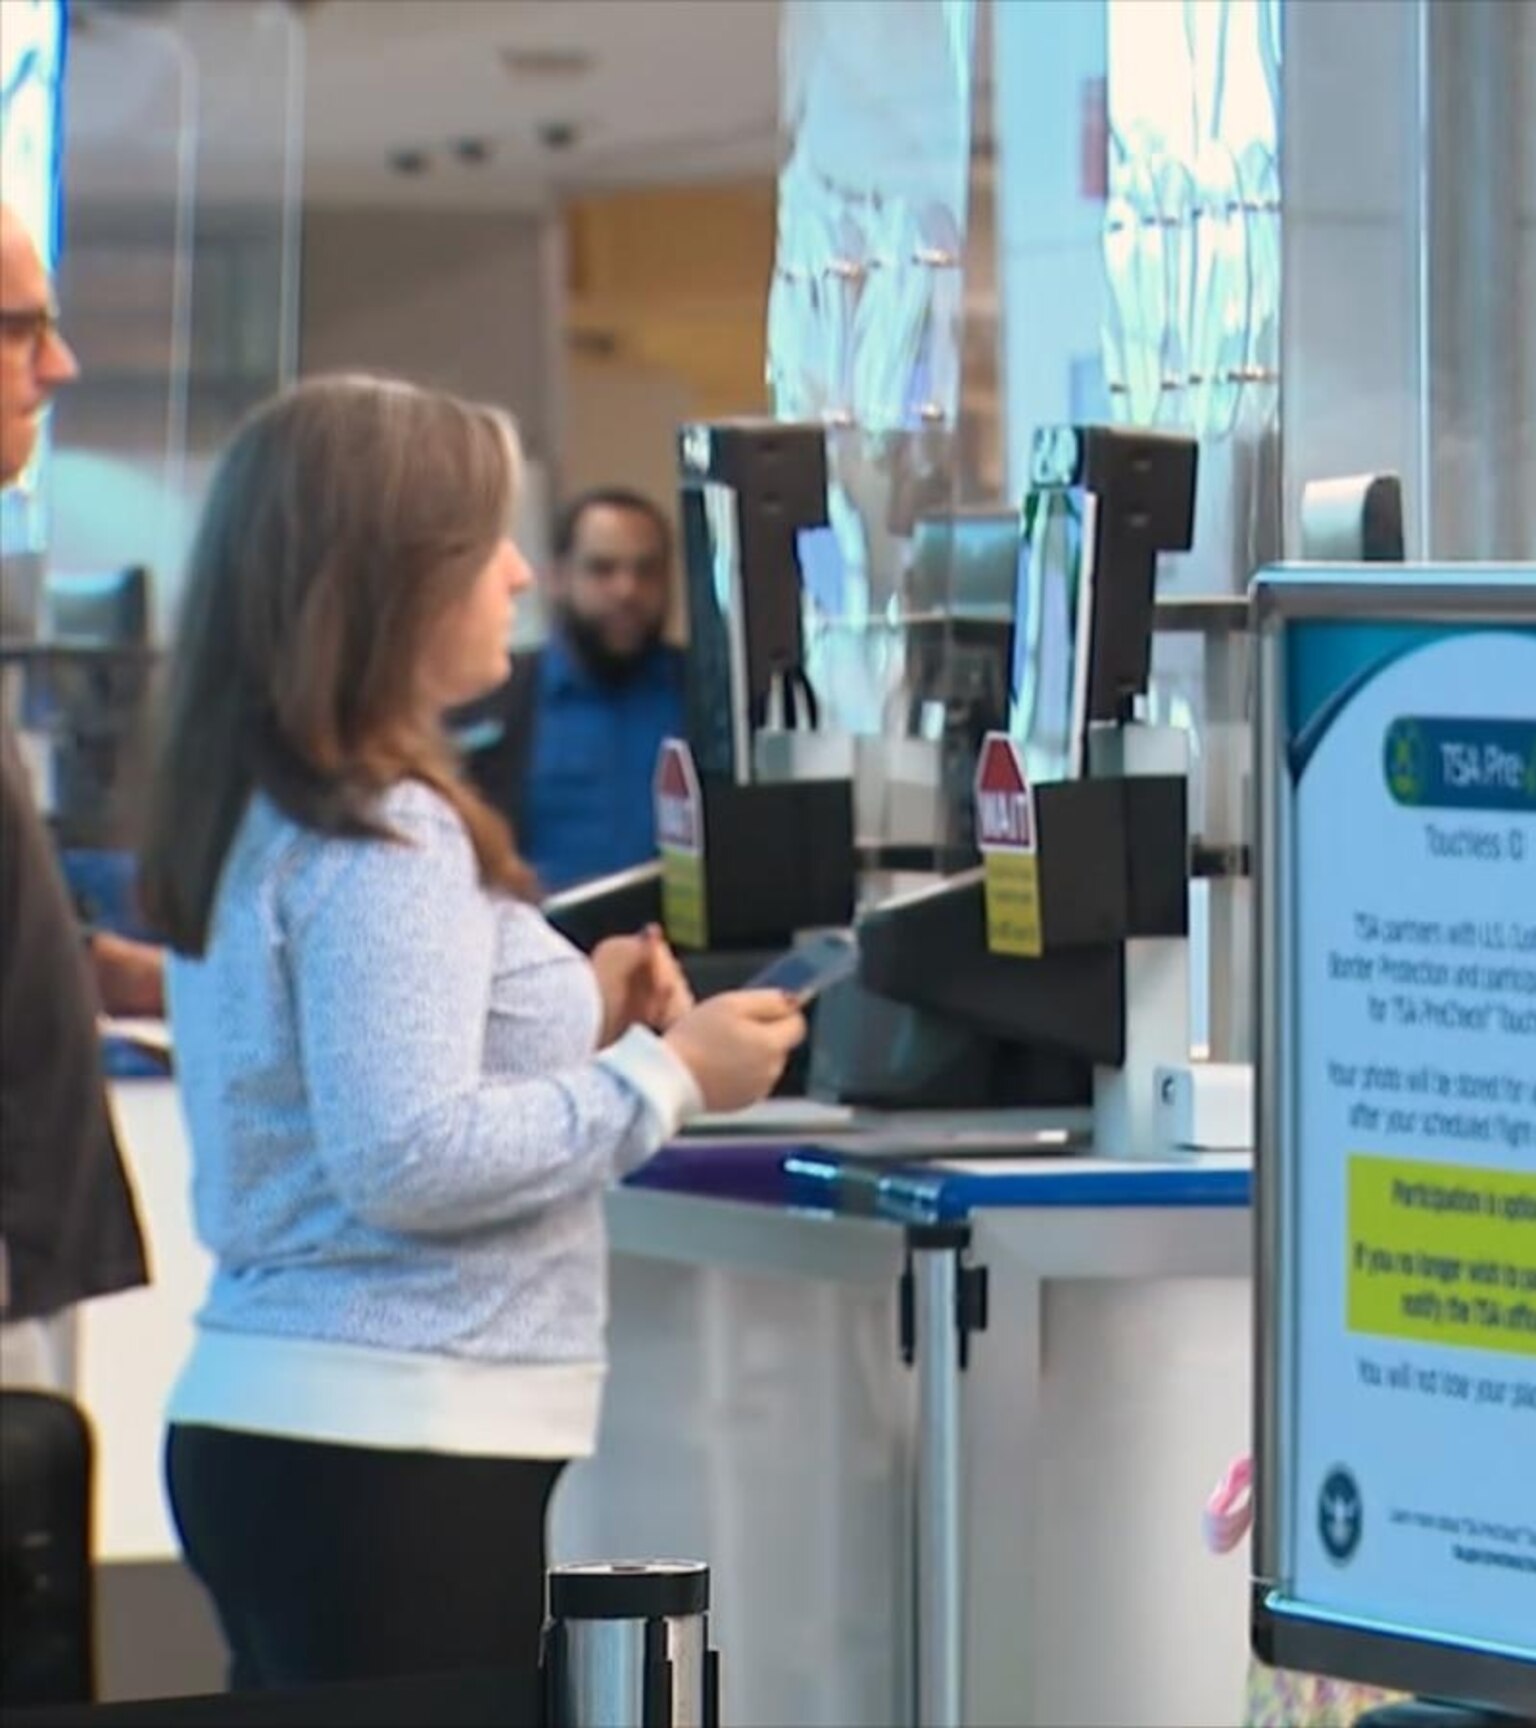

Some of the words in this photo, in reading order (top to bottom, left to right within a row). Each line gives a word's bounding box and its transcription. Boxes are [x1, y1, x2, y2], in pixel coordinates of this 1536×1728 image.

[1440, 743, 1480, 787] TSA
[1425, 823, 1501, 860] Touchless
[1391, 1178, 1480, 1216] Participation
